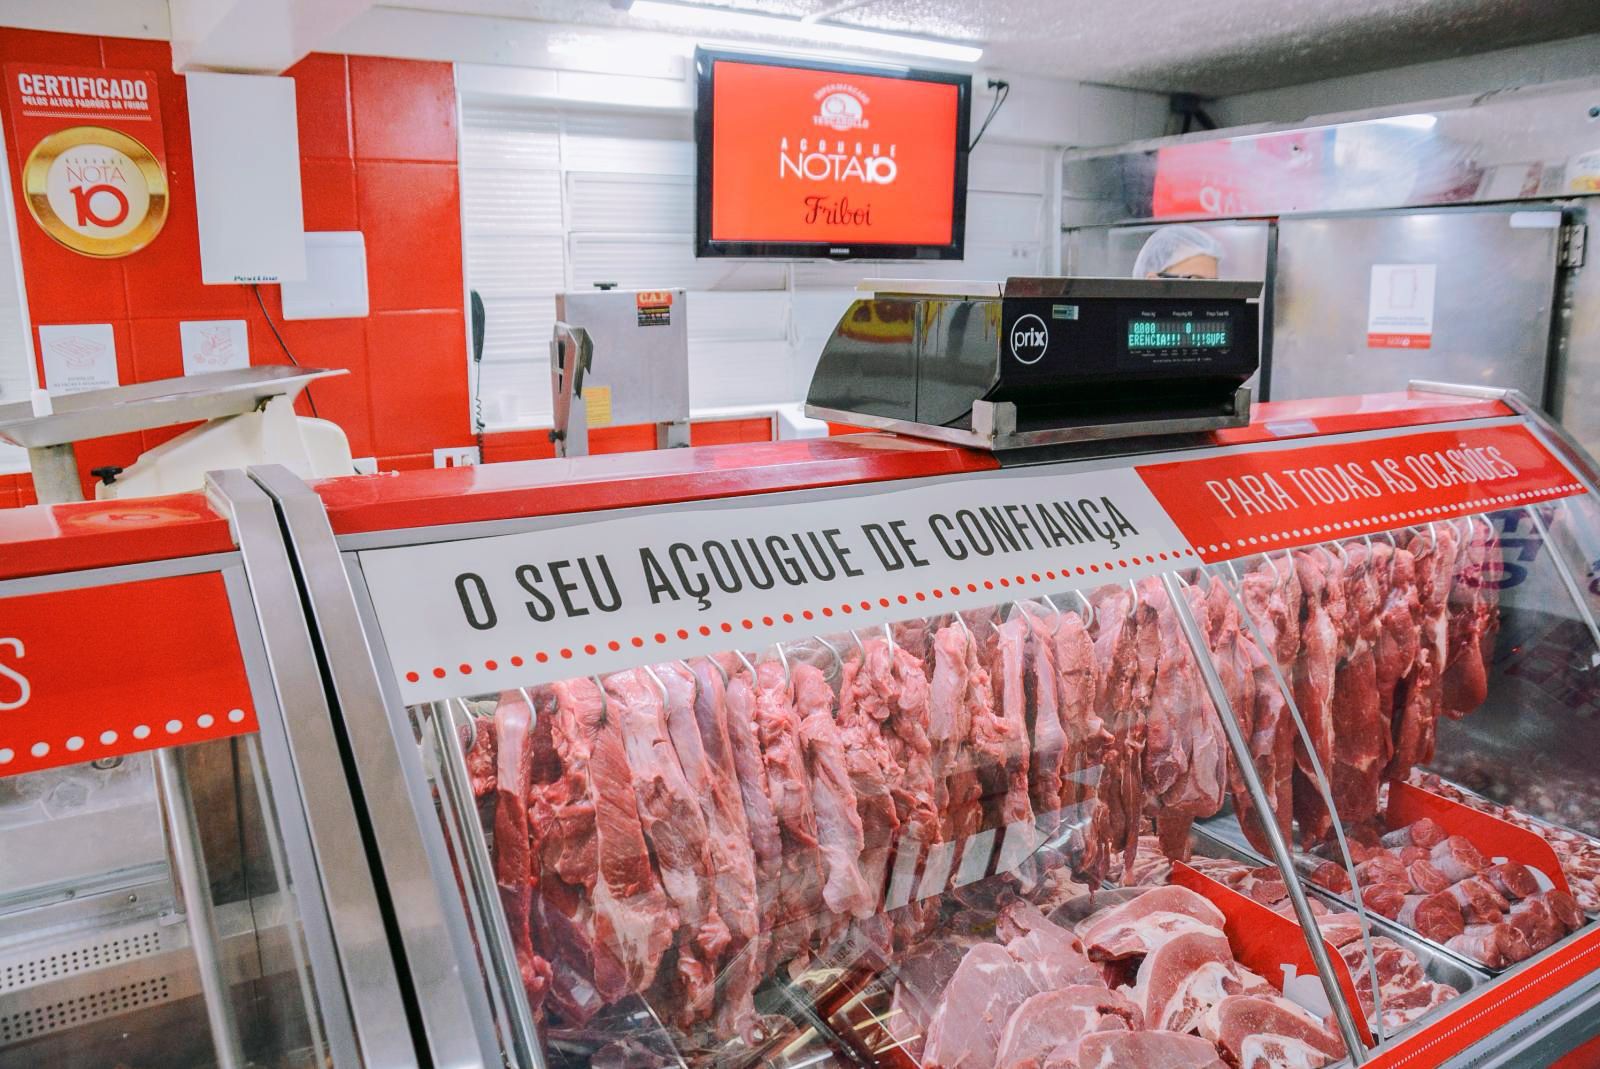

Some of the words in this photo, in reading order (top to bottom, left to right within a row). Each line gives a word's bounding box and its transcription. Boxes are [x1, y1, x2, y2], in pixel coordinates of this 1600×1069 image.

[18, 73, 148, 100] CERTIFICADO
[66, 166, 128, 184] NOTA
[69, 184, 130, 229] 10
[803, 195, 873, 226] Friboi
[1013, 327, 1046, 351] prix
[1206, 471, 1299, 519] PARA
[1282, 461, 1382, 505] TODAS
[1370, 457, 1418, 494] AS
[1404, 441, 1519, 490] OCASIÕES
[454, 572, 498, 631] O
[514, 554, 623, 623] SEU
[638, 528, 864, 612] AÇOUGUE
[861, 519, 931, 572] DE
[927, 496, 1140, 562] CONFIANÇA
